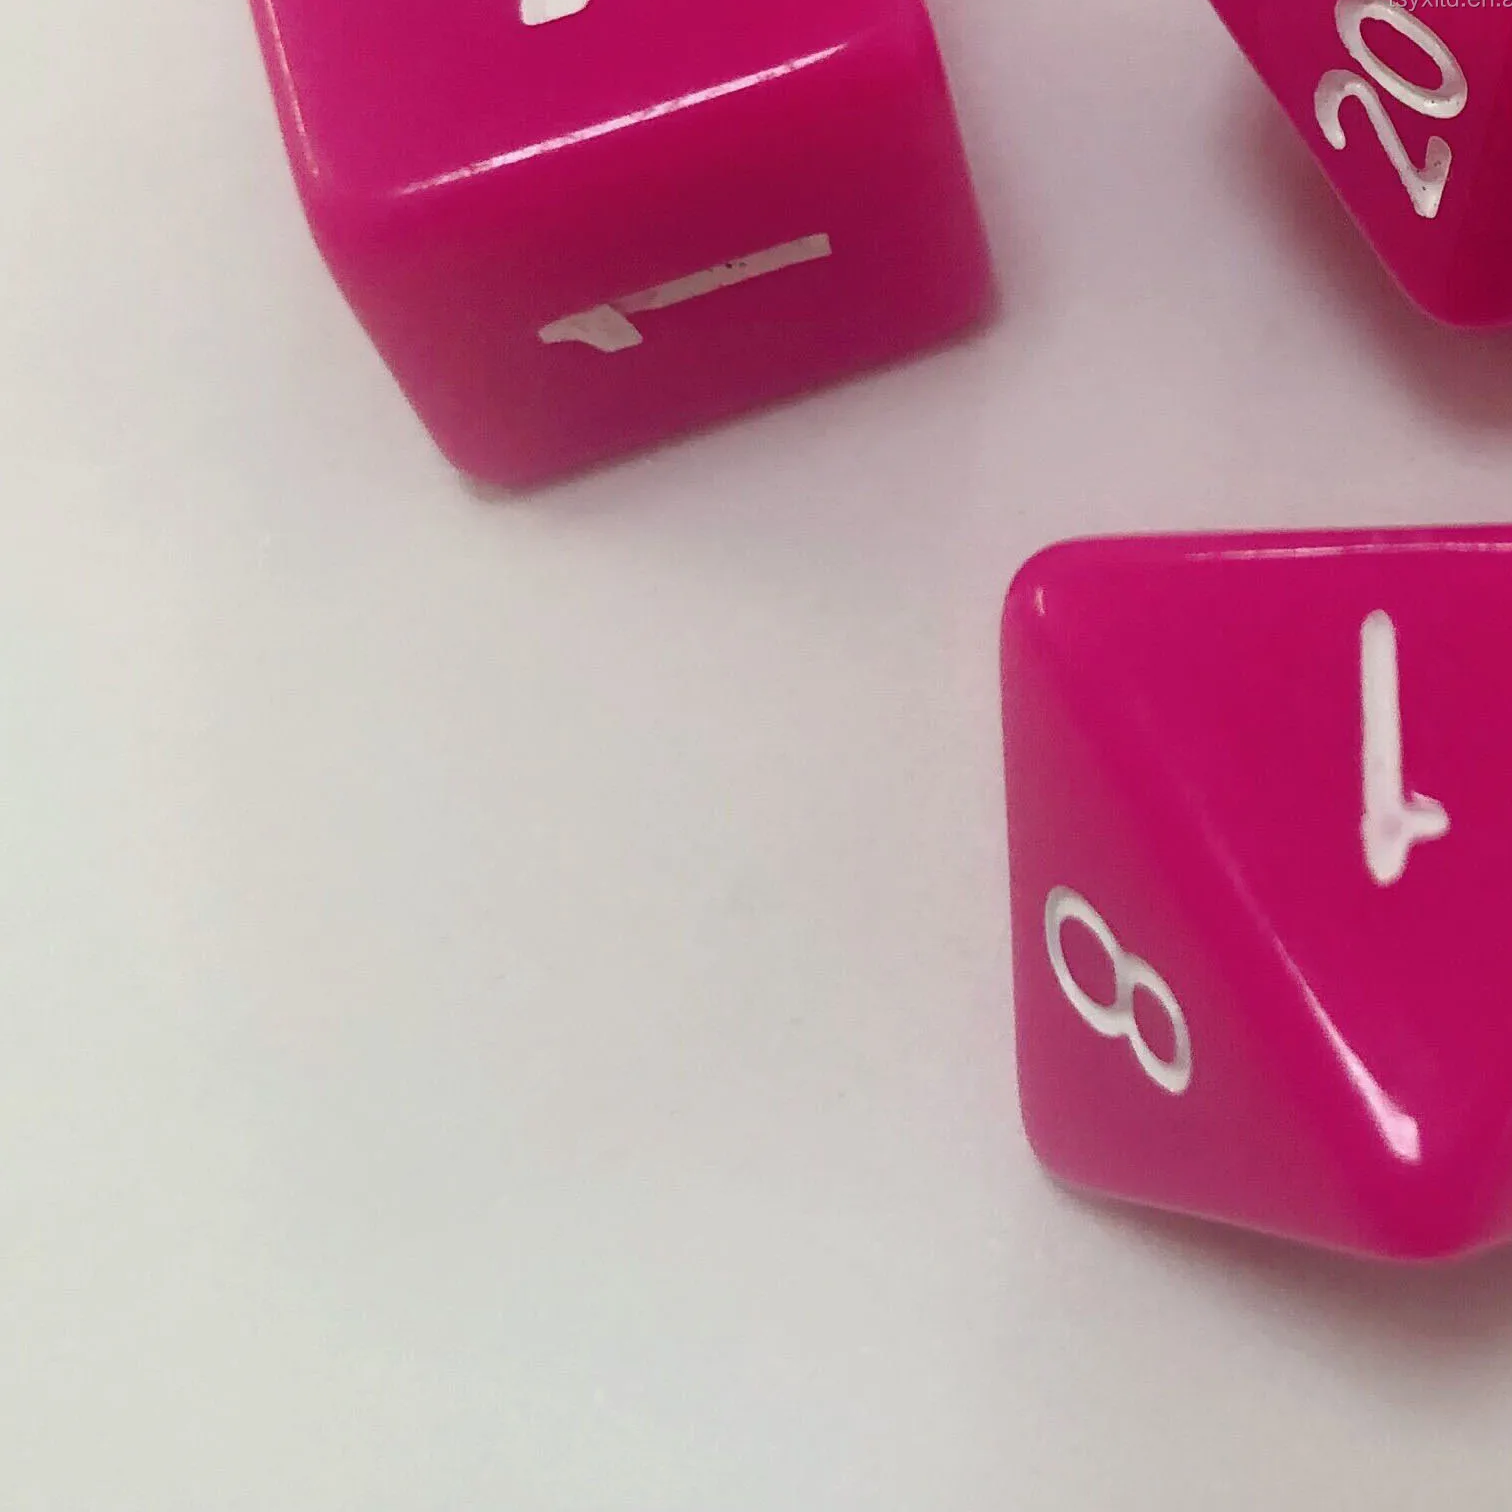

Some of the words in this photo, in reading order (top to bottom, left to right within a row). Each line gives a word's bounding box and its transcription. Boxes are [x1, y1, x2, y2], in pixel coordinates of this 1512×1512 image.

[537, 233, 832, 353] 1
[1360, 610, 1450, 885] 1
[1044, 885, 1192, 1096] 8
